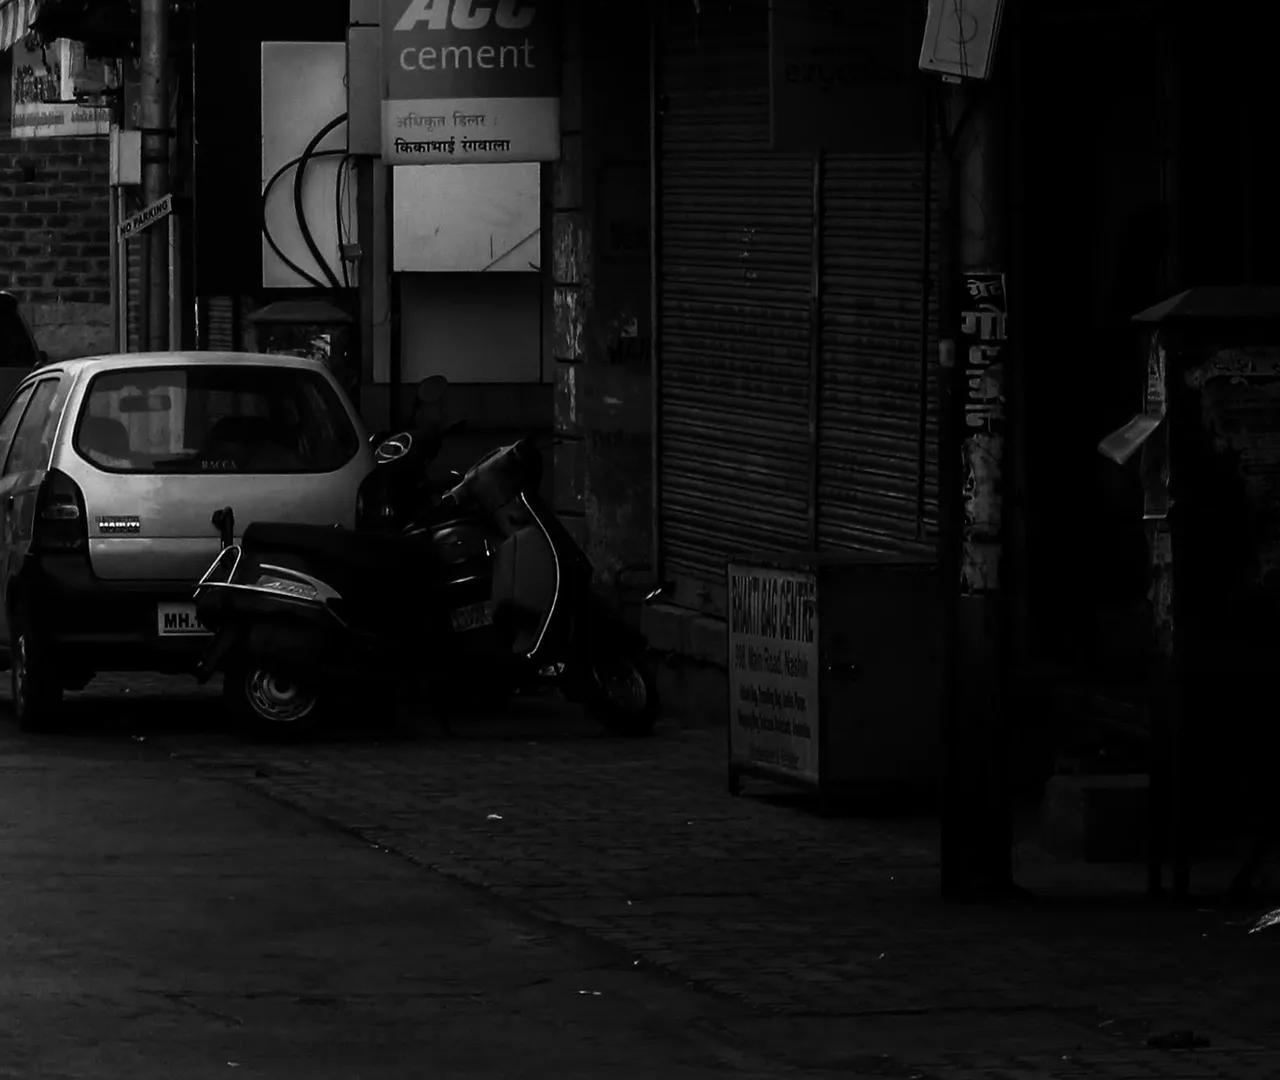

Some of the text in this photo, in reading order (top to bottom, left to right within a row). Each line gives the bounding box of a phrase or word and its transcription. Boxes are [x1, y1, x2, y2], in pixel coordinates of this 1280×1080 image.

[399, 37, 536, 71] cement
[394, 135, 511, 155] किकाभाई रंगवाला
[119, 200, 169, 237] NO PARKING
